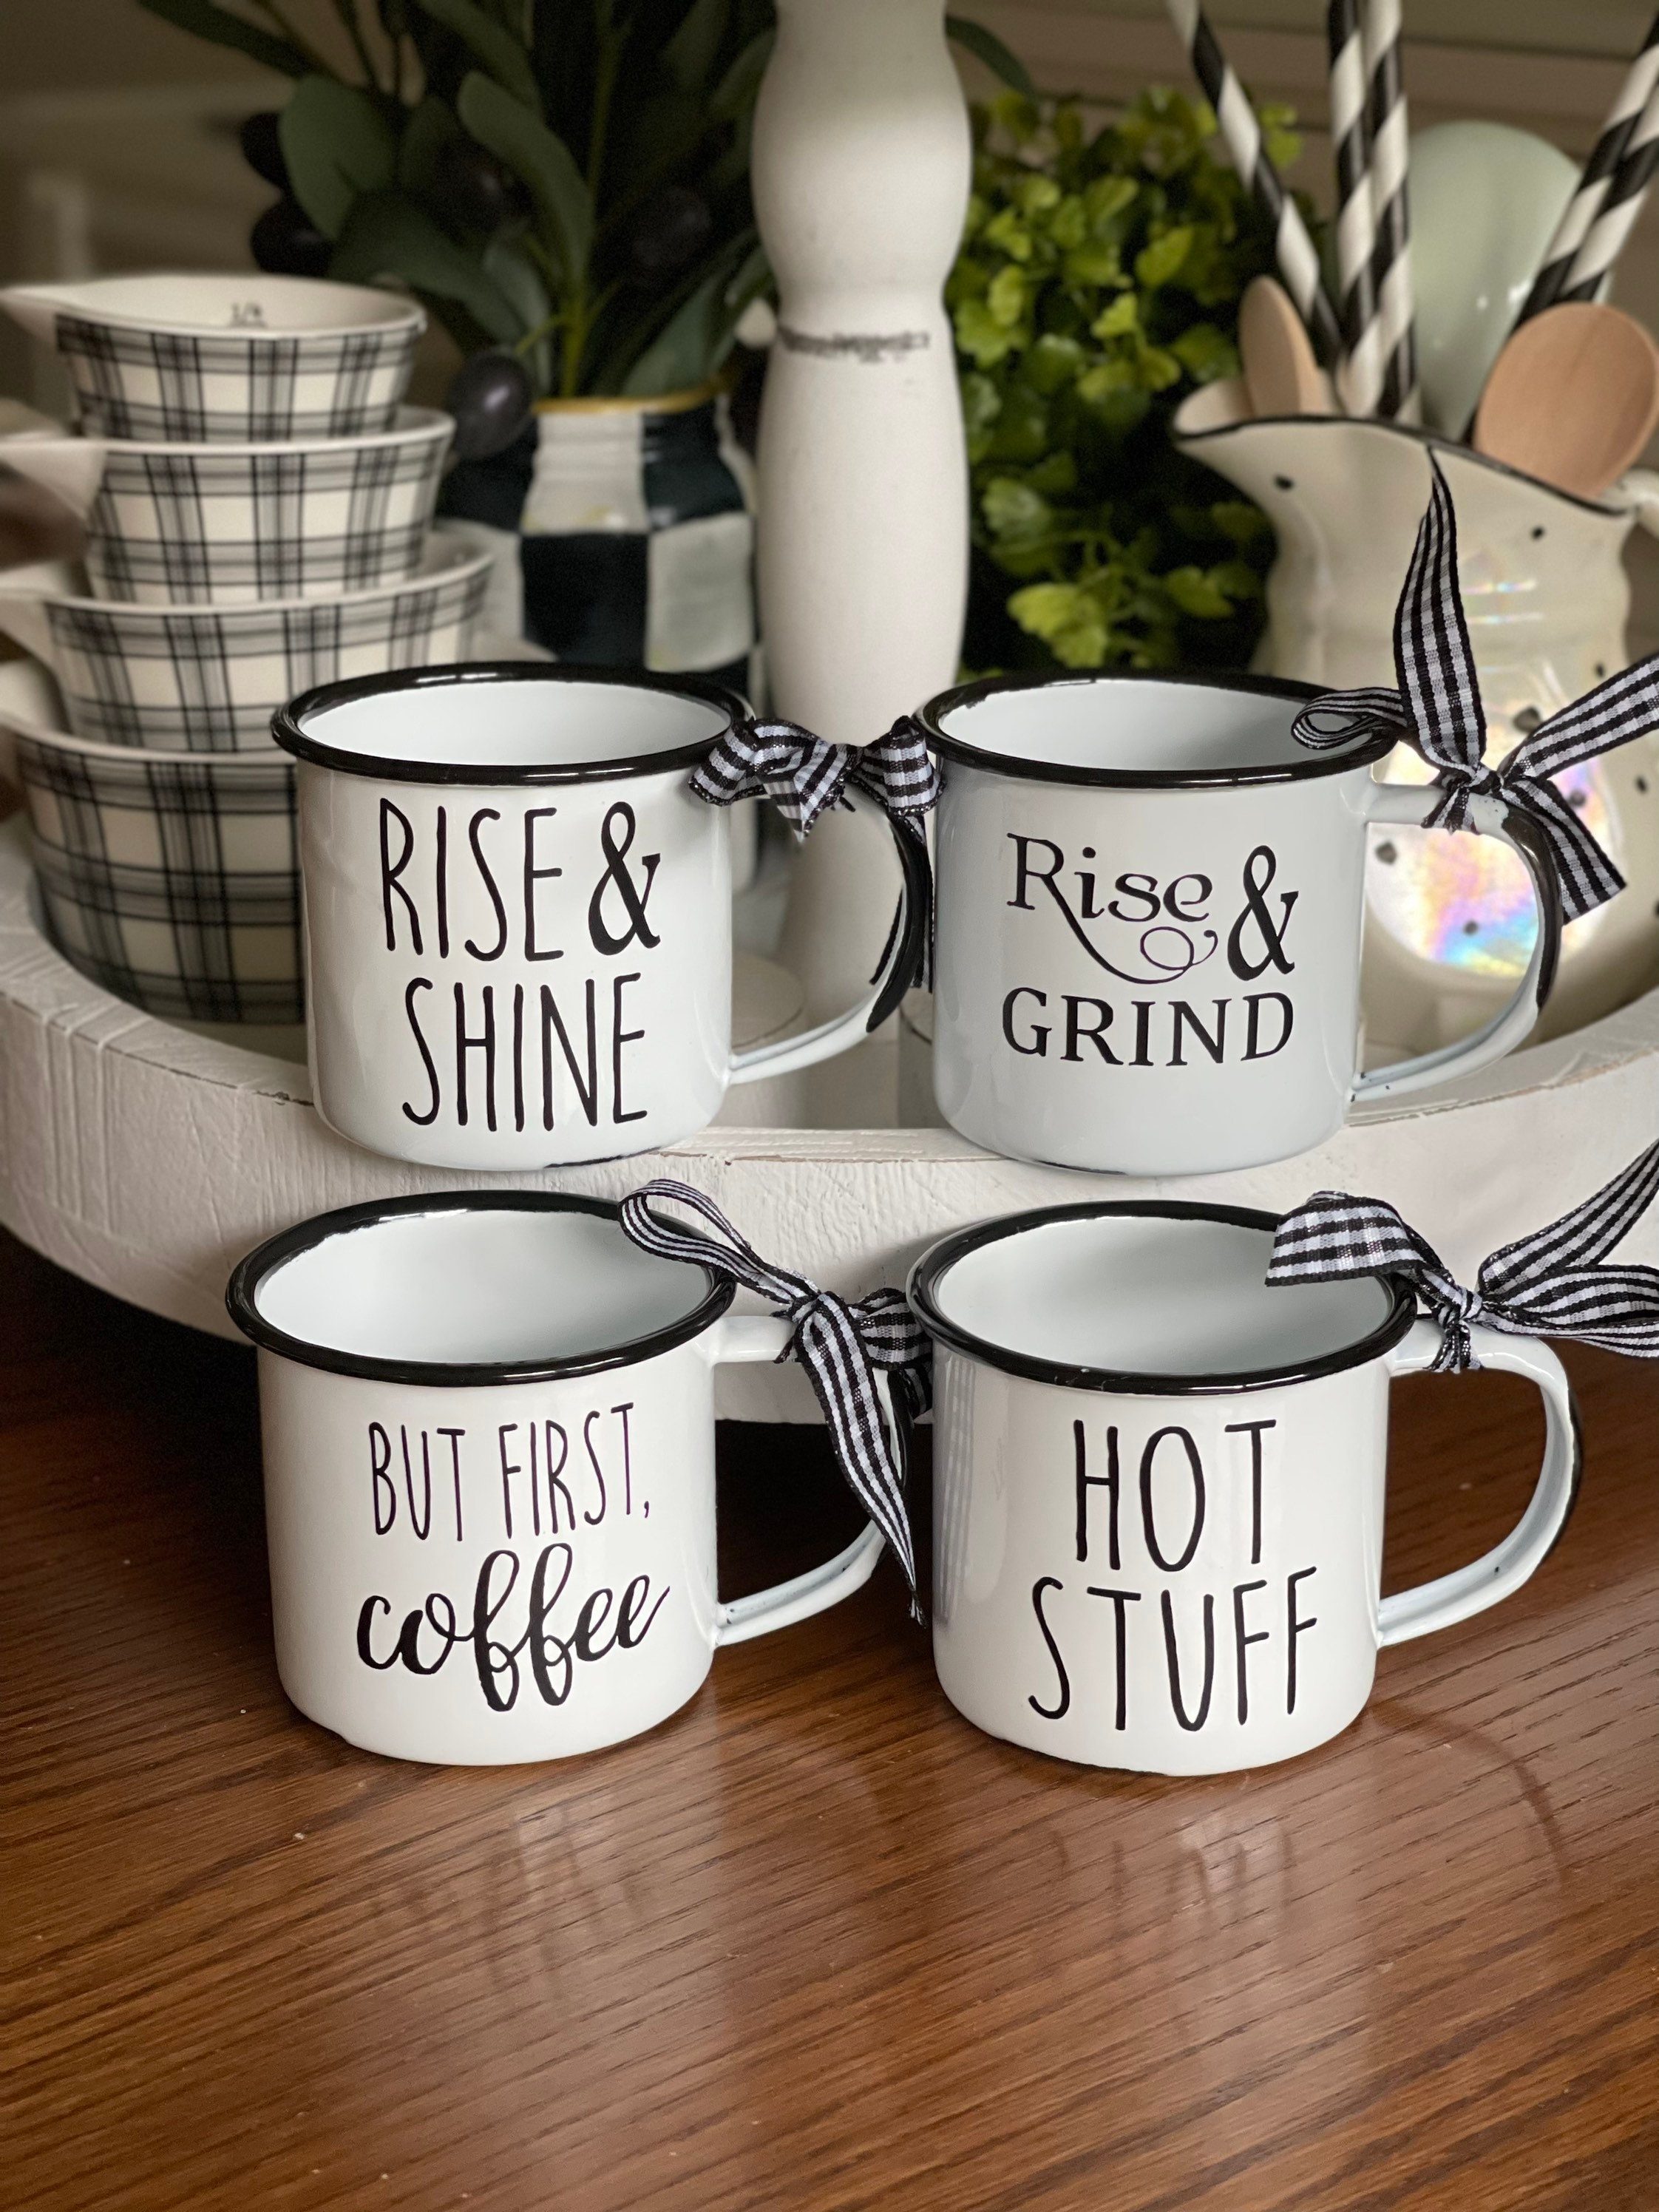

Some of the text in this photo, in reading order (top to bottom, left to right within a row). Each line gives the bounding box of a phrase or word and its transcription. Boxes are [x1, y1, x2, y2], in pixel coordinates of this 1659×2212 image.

[379, 797, 661, 962] RISE &
[1006, 832, 1299, 985] Rise &
[401, 972, 648, 1133] SHINE
[1002, 987, 1294, 1067] GRIND
[368, 1402, 650, 1541] BUT FIRST,
[1073, 1419, 1277, 1573] HOT
[356, 1543, 670, 1712] coffee
[1028, 1566, 1317, 1732] STUFF
